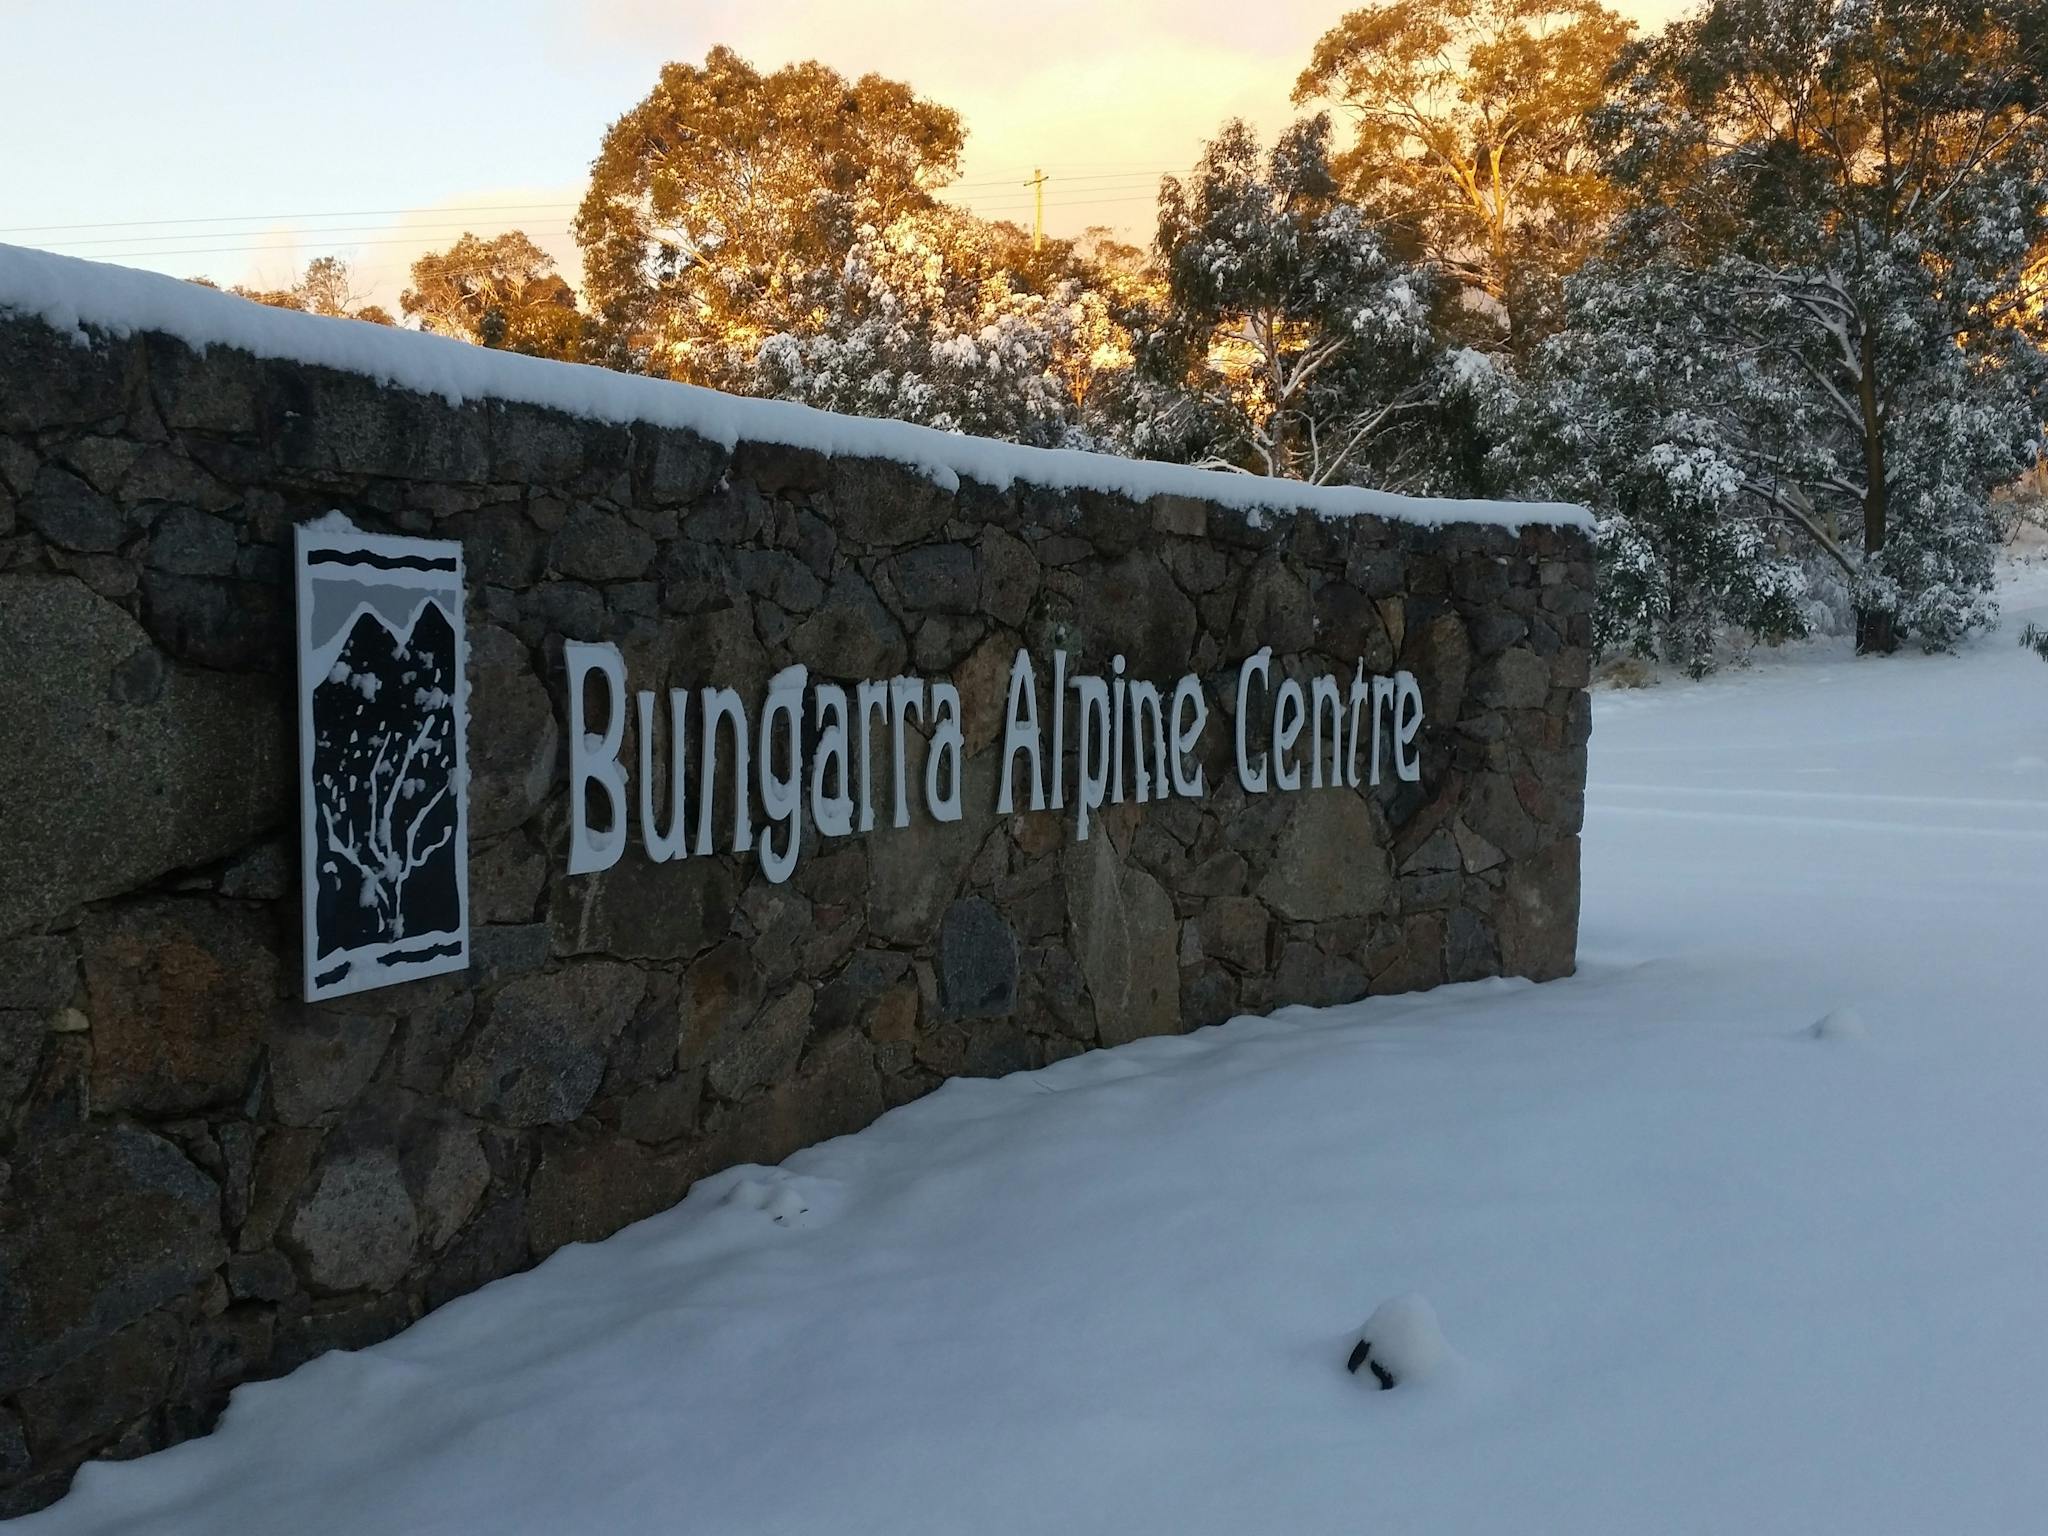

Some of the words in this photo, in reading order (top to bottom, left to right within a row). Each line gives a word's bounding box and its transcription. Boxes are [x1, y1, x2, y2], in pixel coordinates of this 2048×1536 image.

[565, 640, 963, 884] Bungarra
[997, 648, 1209, 841] Alpine
[1236, 646, 1424, 793] Centre
